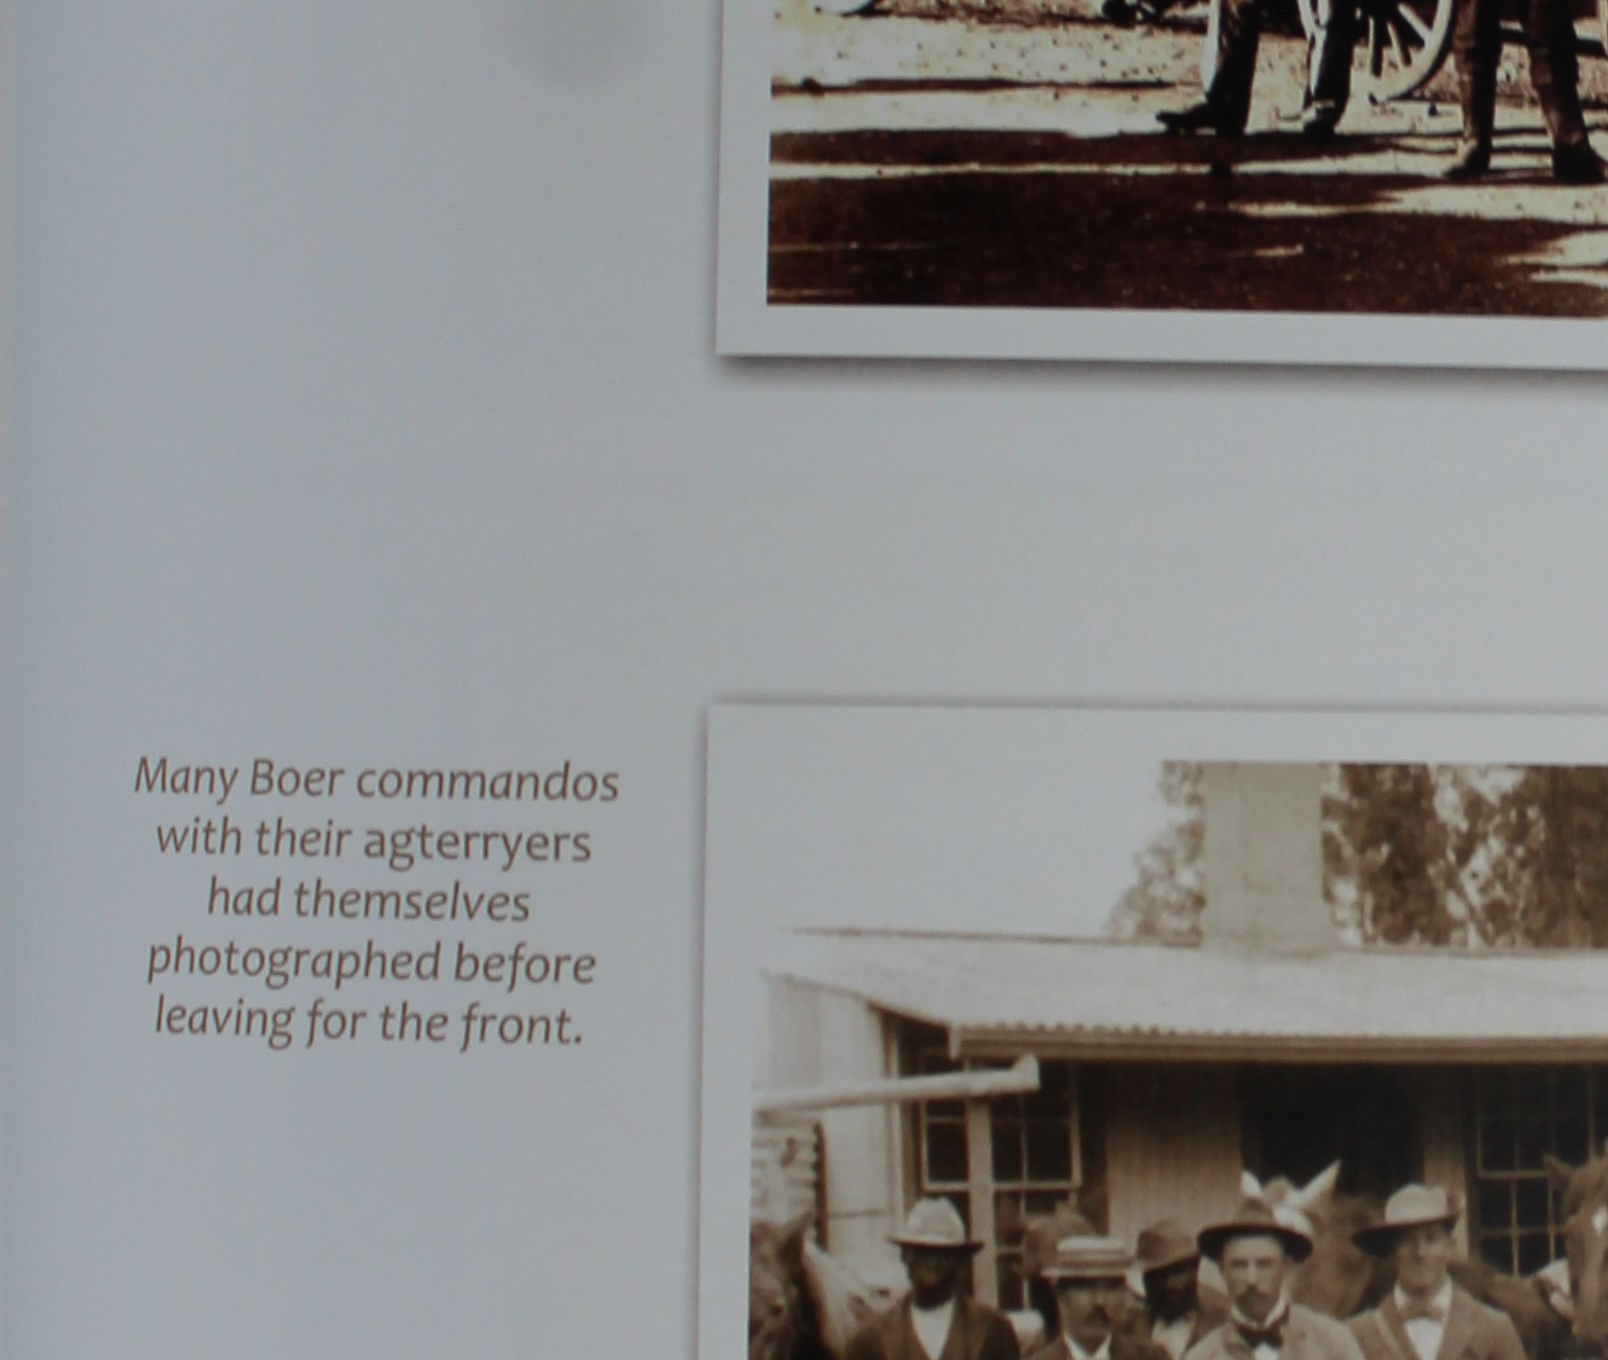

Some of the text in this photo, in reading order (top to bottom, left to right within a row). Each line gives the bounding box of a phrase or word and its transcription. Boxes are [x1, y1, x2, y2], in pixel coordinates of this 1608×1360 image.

[134, 756, 619, 806] Many Boer commandos
[157, 815, 591, 873] with their agterryers
[208, 875, 530, 923] had themselves
[147, 934, 596, 993] photographed before
[156, 993, 582, 1054] leaving for the front.
